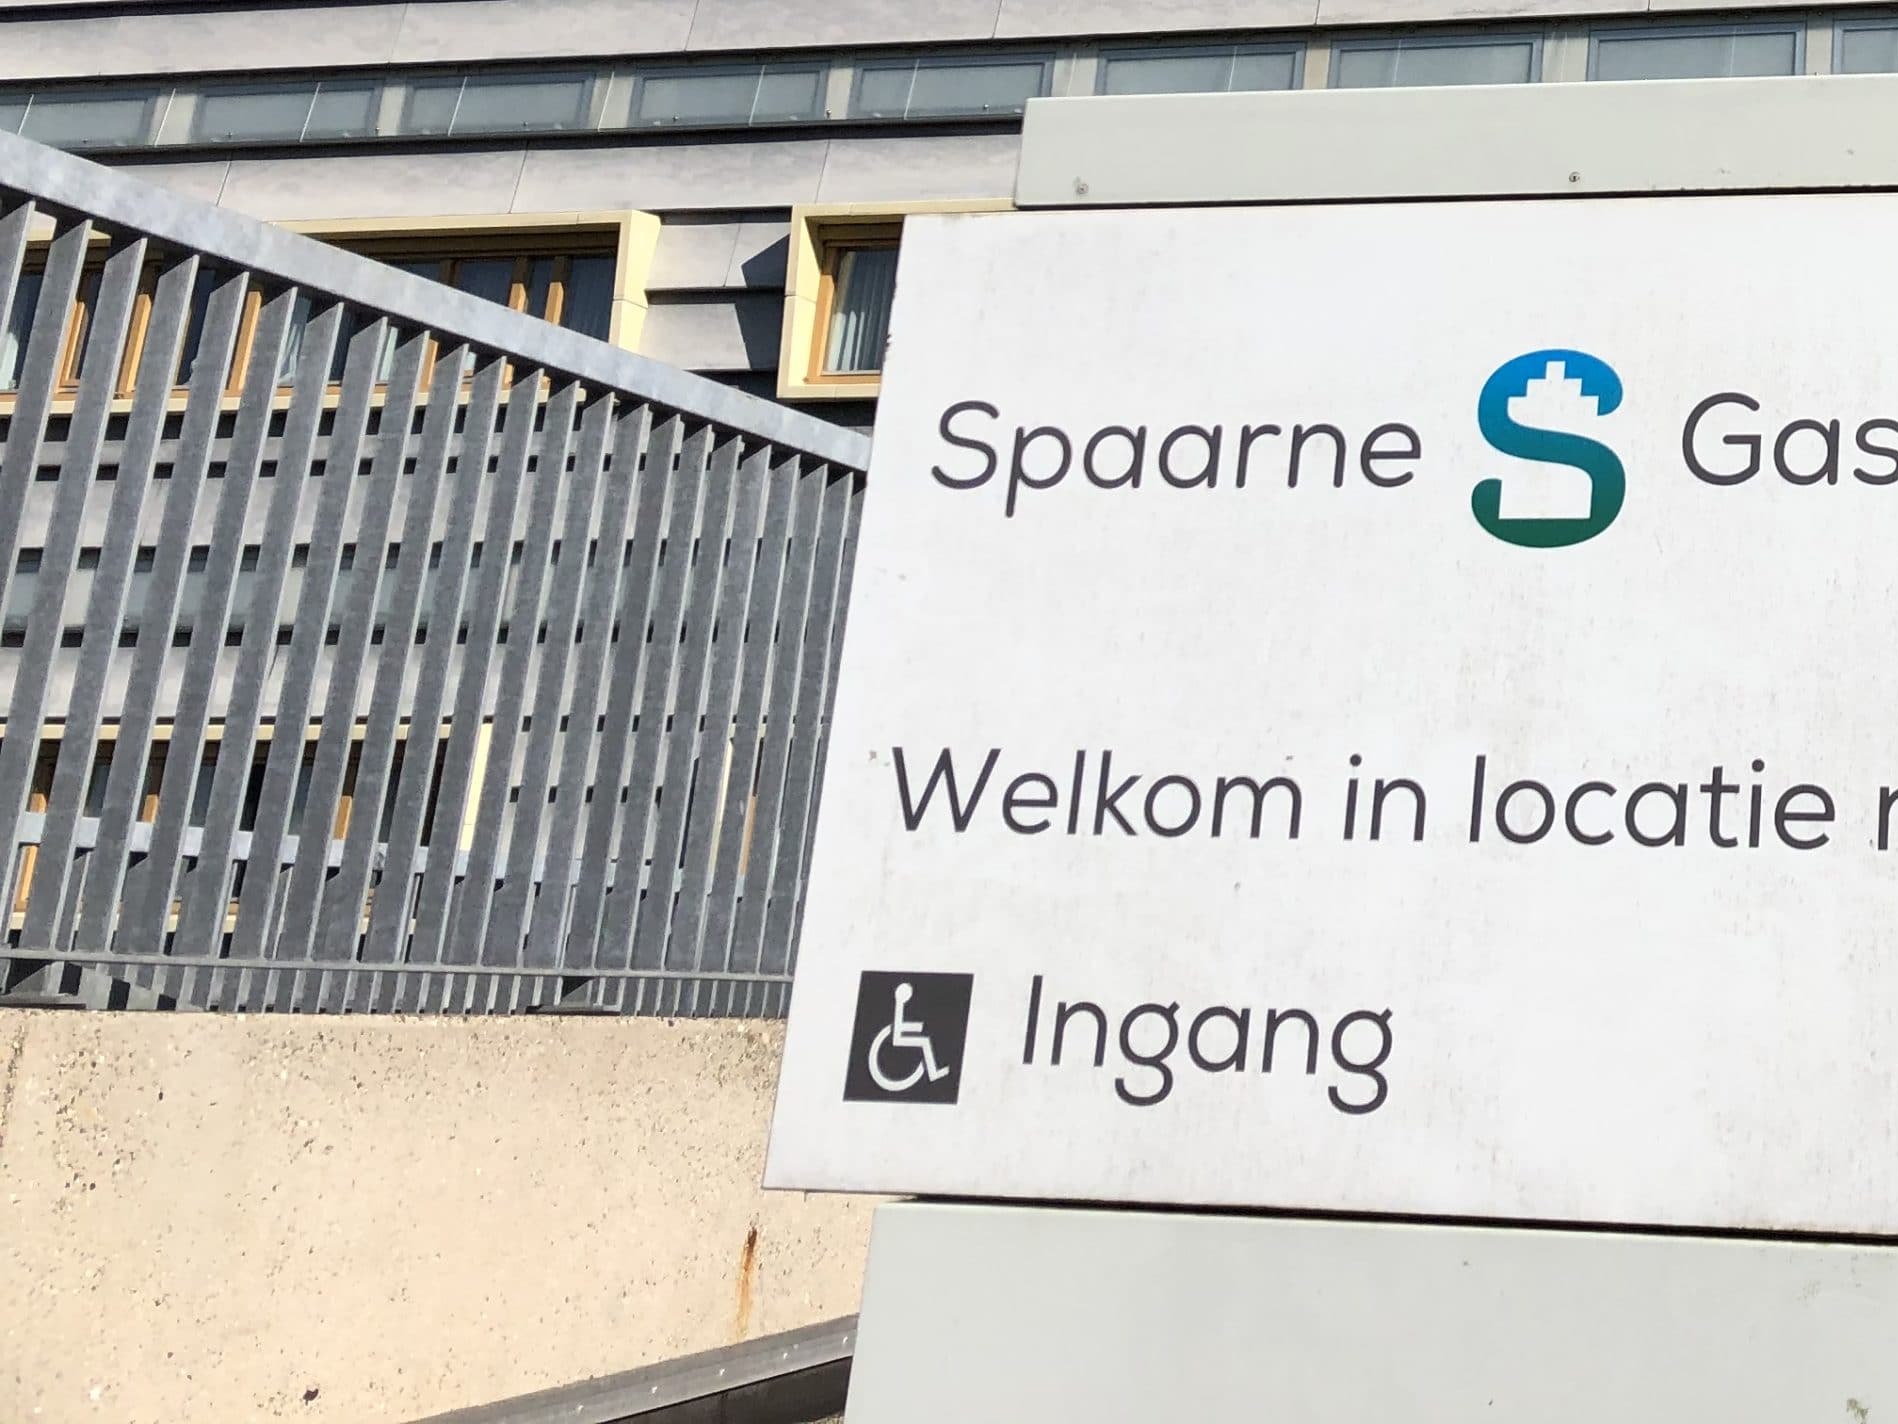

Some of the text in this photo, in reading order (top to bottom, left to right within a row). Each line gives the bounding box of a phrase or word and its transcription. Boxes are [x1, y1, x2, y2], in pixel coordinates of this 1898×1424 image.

[931, 400, 1422, 518] Spaarne
[892, 746, 1302, 839] Welkom
[1343, 754, 1426, 841] in
[1469, 755, 1836, 850] locatie
[1023, 975, 1393, 1115] Ingang
